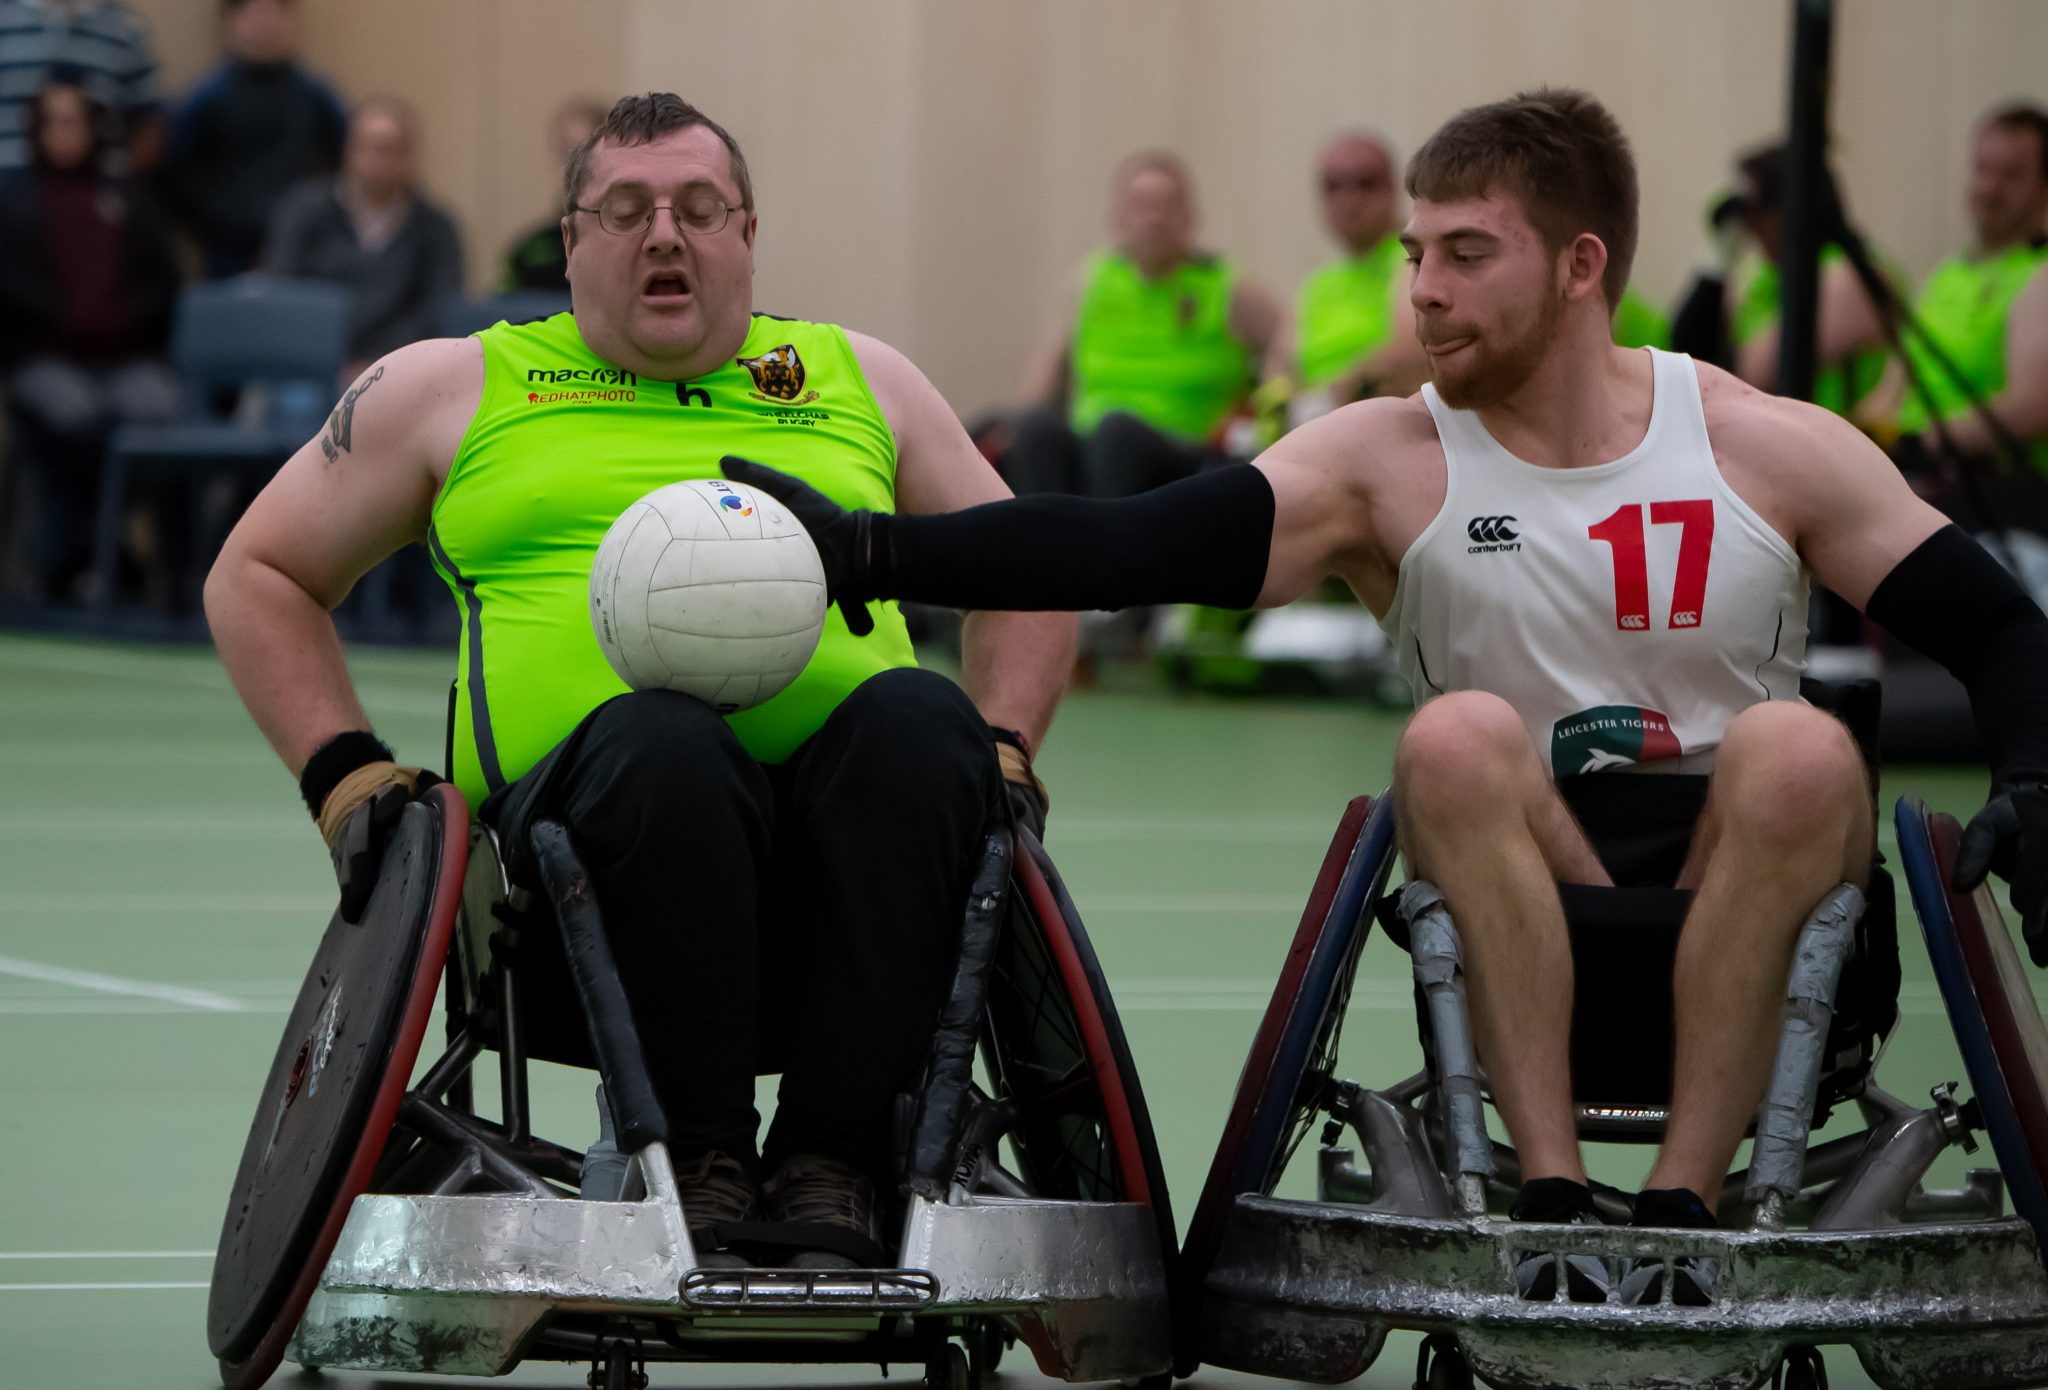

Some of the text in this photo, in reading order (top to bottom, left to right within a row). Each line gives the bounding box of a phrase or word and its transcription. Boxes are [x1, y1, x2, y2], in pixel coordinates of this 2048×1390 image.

[528, 367, 637, 386] macron
[527, 389, 637, 405] REDHATPHOTO
[1468, 542, 1521, 554] canterbury
[1588, 499, 1715, 631] 17
[1558, 719, 1664, 739] LEICESTER TIGERS
